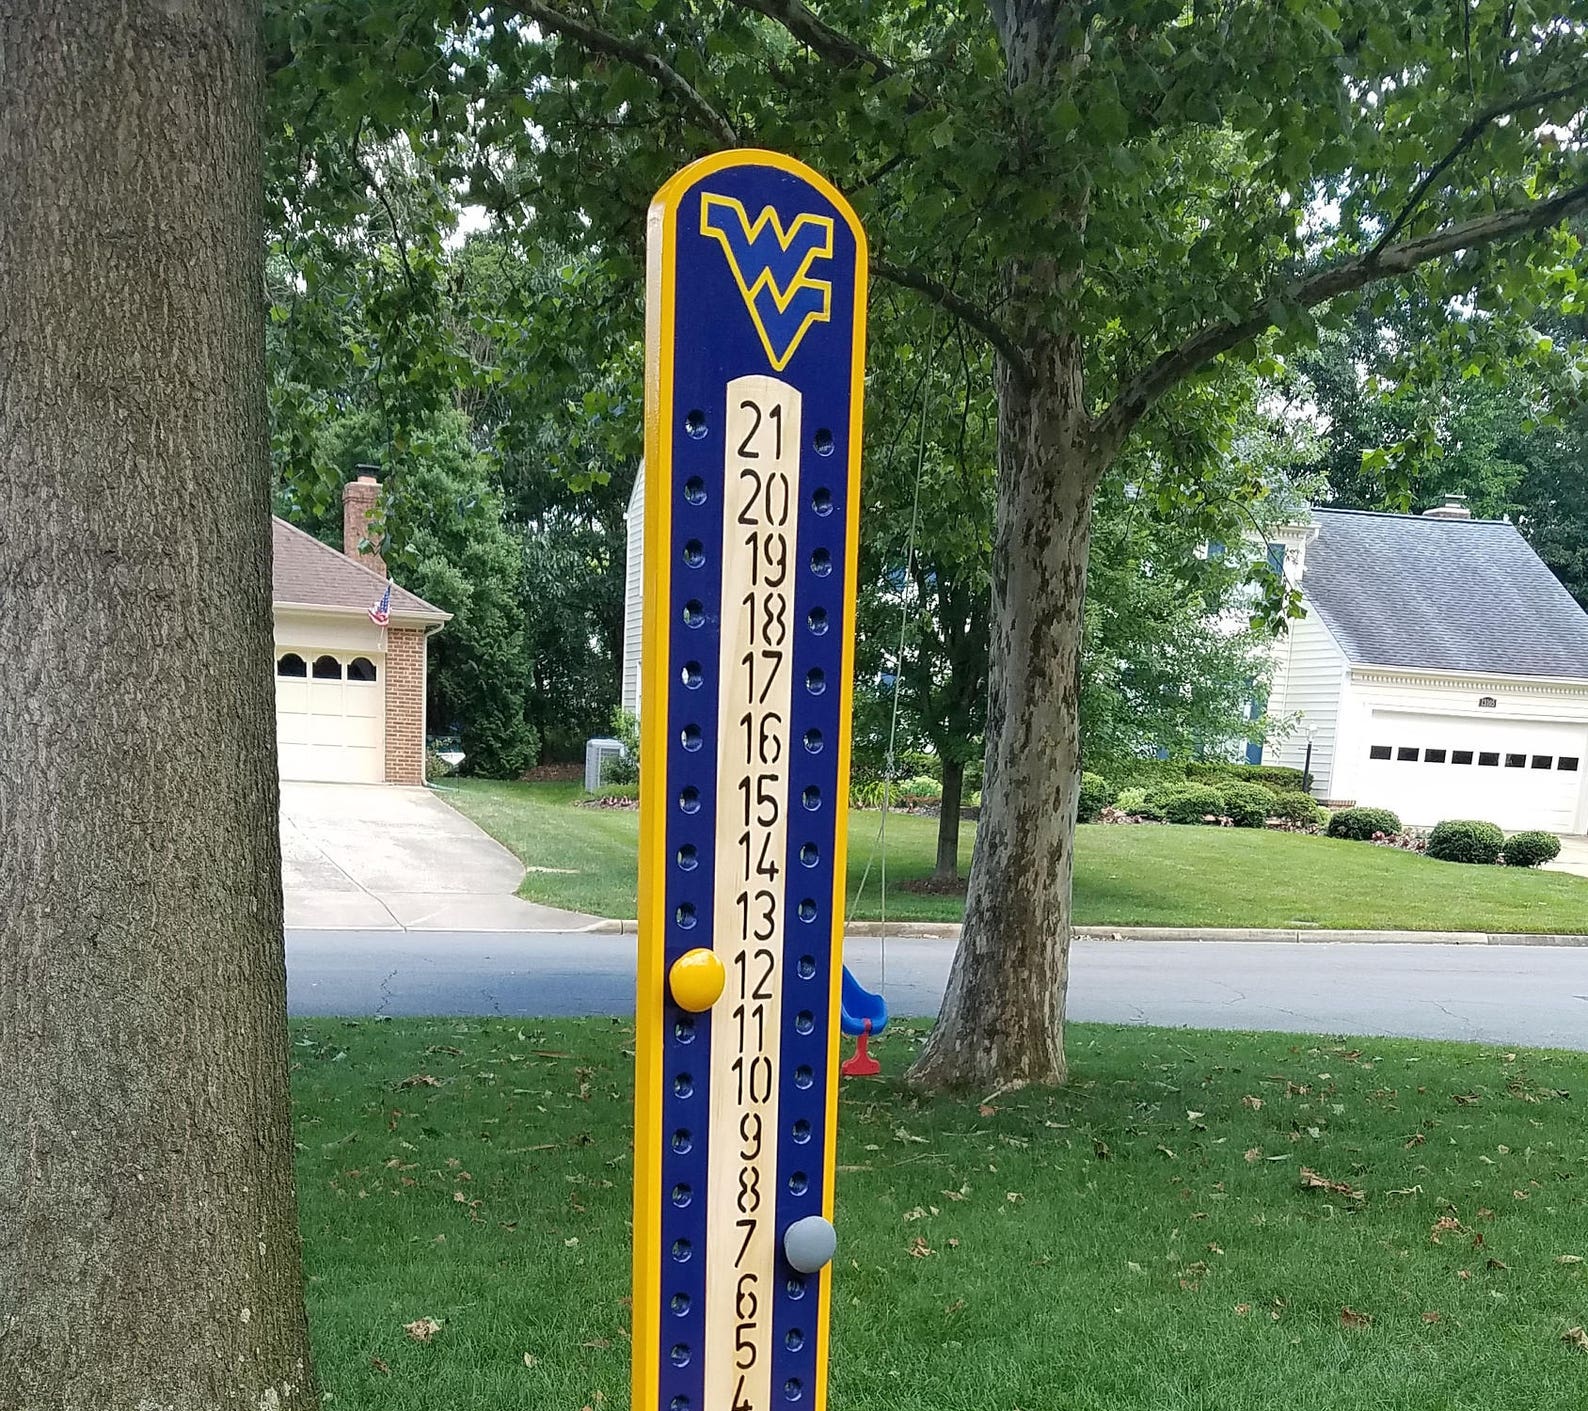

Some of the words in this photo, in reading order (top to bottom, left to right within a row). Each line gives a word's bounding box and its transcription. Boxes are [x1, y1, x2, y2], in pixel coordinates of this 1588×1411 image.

[736, 399, 783, 460] 21
[736, 467, 790, 527] 20
[744, 530, 788, 588] 19
[741, 590, 788, 647] 18
[740, 648, 784, 705] 17
[738, 710, 783, 765] 16
[737, 772, 780, 828] 15
[737, 829, 781, 883] 14
[735, 888, 777, 941] 13
[733, 947, 776, 1001] 12
[731, 1002, 765, 1054] 11
[730, 1054, 773, 1106] 10
[738, 1111, 763, 1161] 9
[736, 1164, 762, 1214] 8
[733, 1218, 758, 1269] 7
[734, 1272, 759, 1321] 6
[734, 1321, 758, 1370] 5
